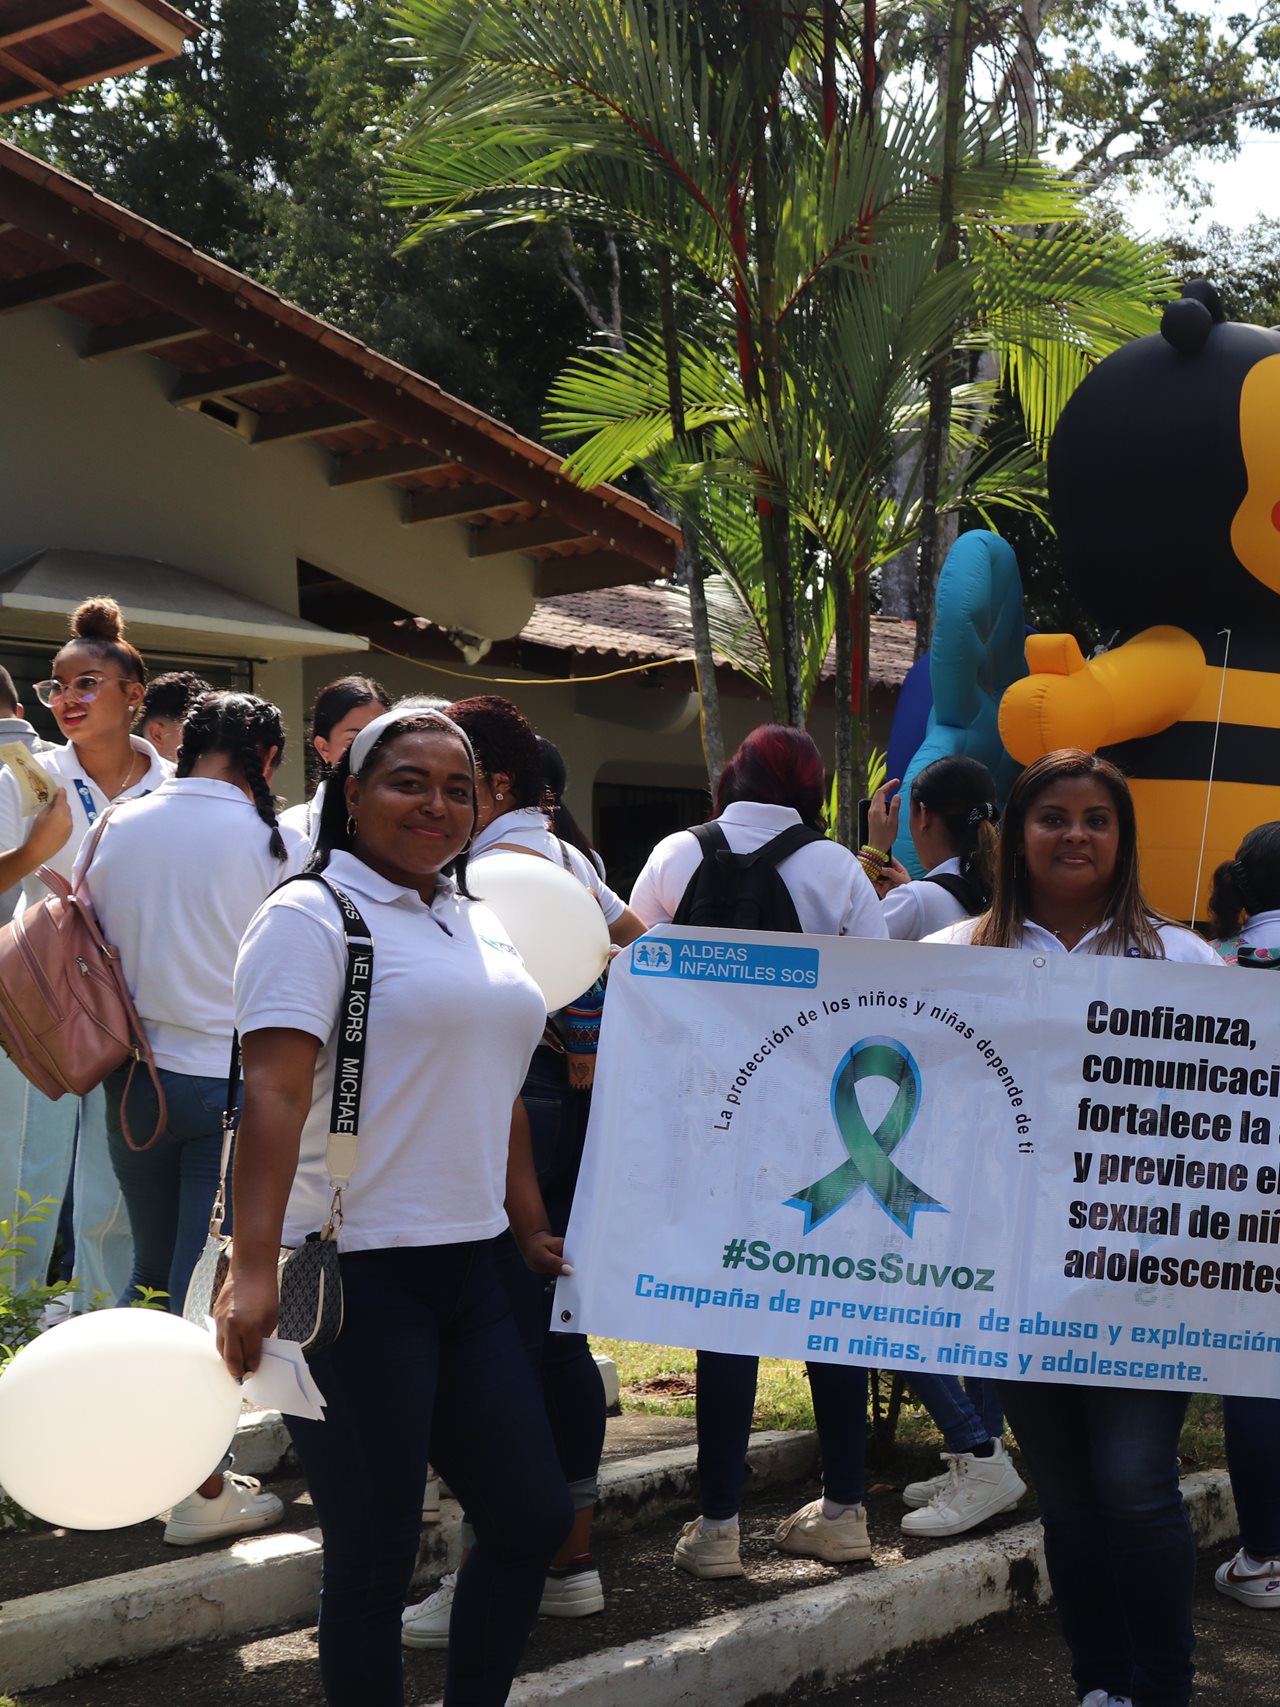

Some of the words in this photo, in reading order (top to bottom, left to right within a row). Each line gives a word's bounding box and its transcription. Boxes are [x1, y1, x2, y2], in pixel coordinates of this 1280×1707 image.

[680, 944, 748, 962] ALDEAS
[679, 961, 776, 981] INFANTILES
[780, 968, 816, 984] SOS
[345, 990, 366, 1042] KORS
[797, 1010, 818, 1027] de
[822, 998, 850, 1015] los
[858, 991, 908, 1008] niños
[913, 1000, 926, 1016] y
[930, 1005, 975, 1040] niñas
[1086, 1000, 1257, 1051] Confianza,
[726, 1025, 794, 1106] protección
[976, 1039, 1024, 1107] depende
[714, 1110, 734, 1131] La
[1015, 1113, 1032, 1134] de
[1077, 1097, 1232, 1144] fortalece
[1239, 1110, 1270, 1146] la
[1018, 1141, 1034, 1153] ti
[1073, 1151, 1093, 1184] y
[1099, 1152, 1248, 1193] previene
[1068, 1199, 1181, 1237] sexual
[1188, 1204, 1230, 1240] de
[722, 1238, 995, 1292] #SomosSuvoz
[635, 1273, 760, 1309] Campaña
[768, 1289, 801, 1314] de
[809, 1298, 961, 1330] prevención
[978, 1308, 1010, 1332] de
[1019, 1311, 1099, 1340] abuso
[1107, 1323, 1123, 1346] y
[807, 1334, 839, 1353] en
[848, 1331, 928, 1364] niñas,
[937, 1341, 1008, 1369] niños
[1018, 1352, 1033, 1375] y
[1041, 1349, 1209, 1382] adolescente.
